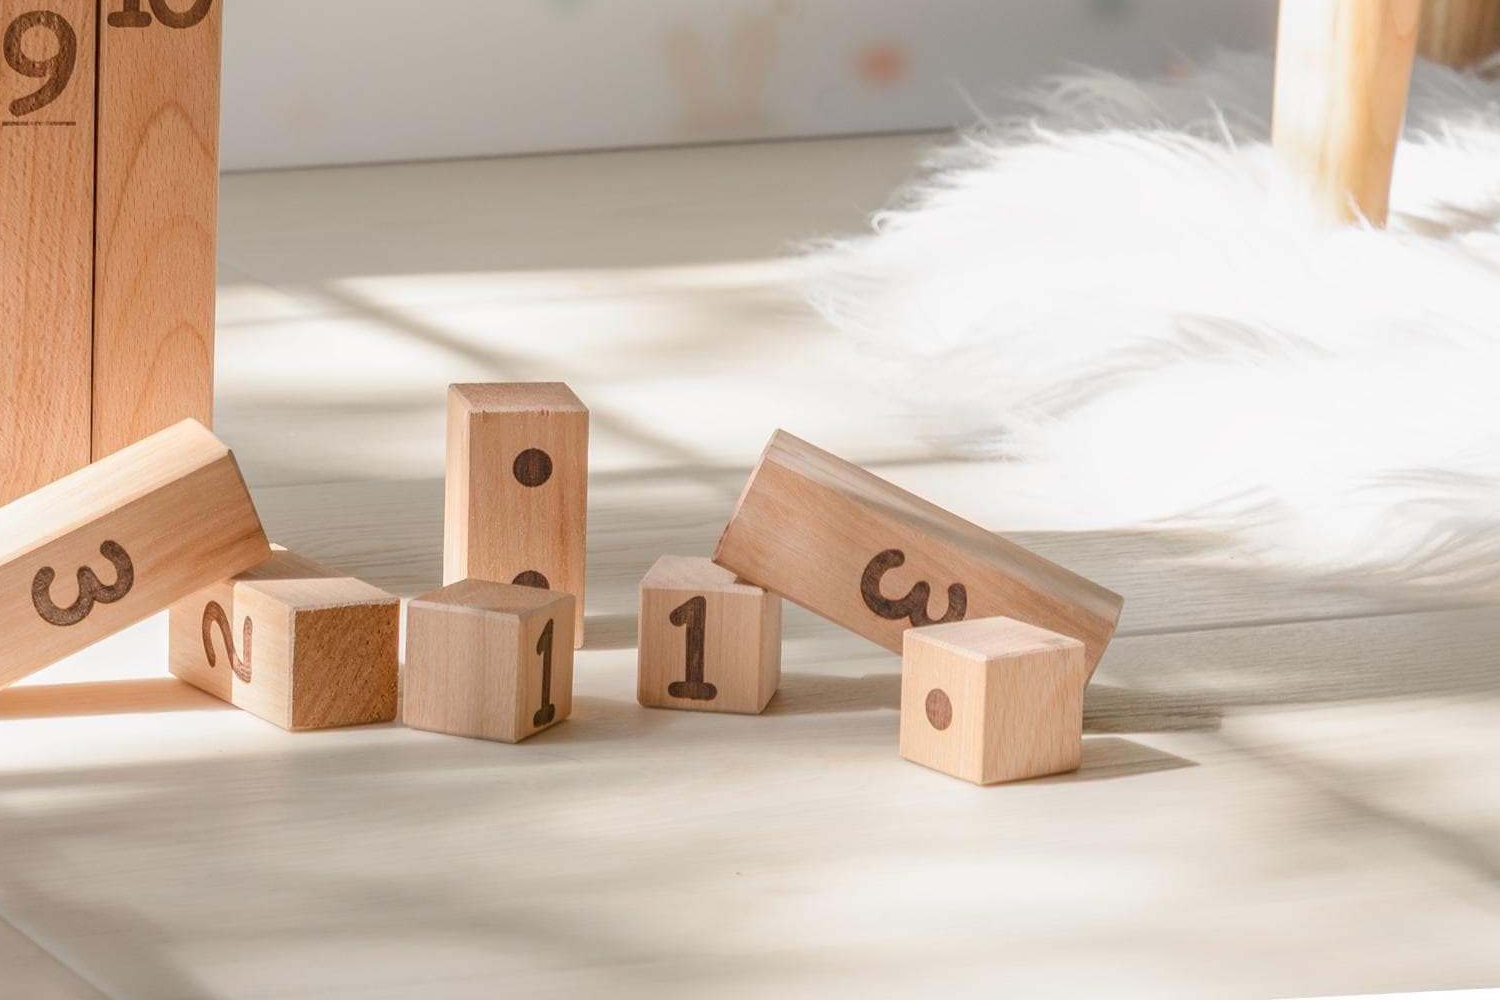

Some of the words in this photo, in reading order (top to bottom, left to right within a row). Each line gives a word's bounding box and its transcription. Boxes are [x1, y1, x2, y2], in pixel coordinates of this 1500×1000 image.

[3, 10, 77, 117] 9
[31, 539, 135, 627] 3
[860, 548, 968, 628] 3
[201, 599, 252, 684] 2
[532, 617, 555, 728] 1
[668, 595, 718, 701] 1
